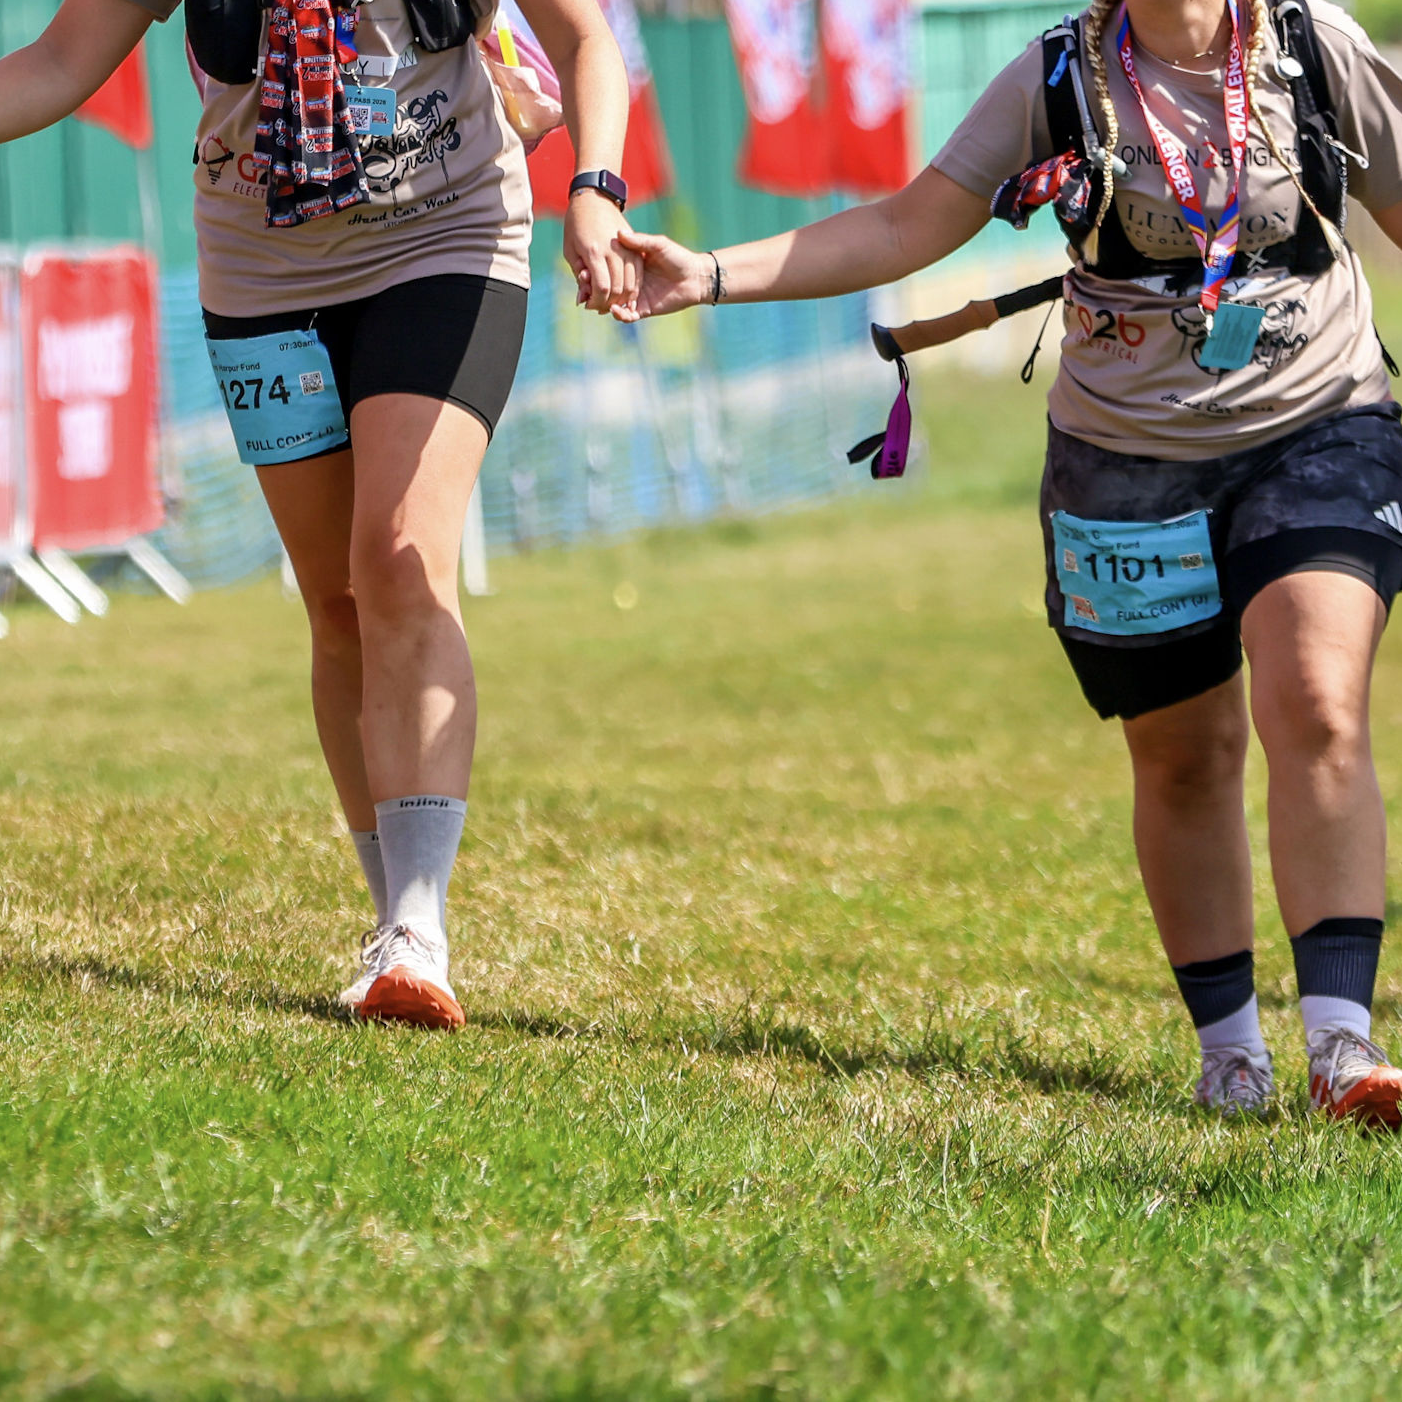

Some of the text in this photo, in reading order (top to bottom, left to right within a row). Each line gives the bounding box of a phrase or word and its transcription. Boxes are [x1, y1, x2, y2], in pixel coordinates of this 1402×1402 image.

[232, 183, 268, 199] ELECT
[347, 192, 460, 226] Hand Car Wash
[279, 340, 317, 352] 07:30am
[240, 362, 261, 371] Fund
[219, 374, 291, 410] 1274
[1160, 393, 1201, 411] Hand
[1207, 403, 1233, 414] Car
[245, 439, 275, 452] FULL
[1116, 541, 1141, 551] Fund
[1084, 552, 1166, 584] 1101
[1116, 609, 1148, 622] FULL
[1150, 599, 1188, 619] CONT
[398, 798, 450, 809] injinji
